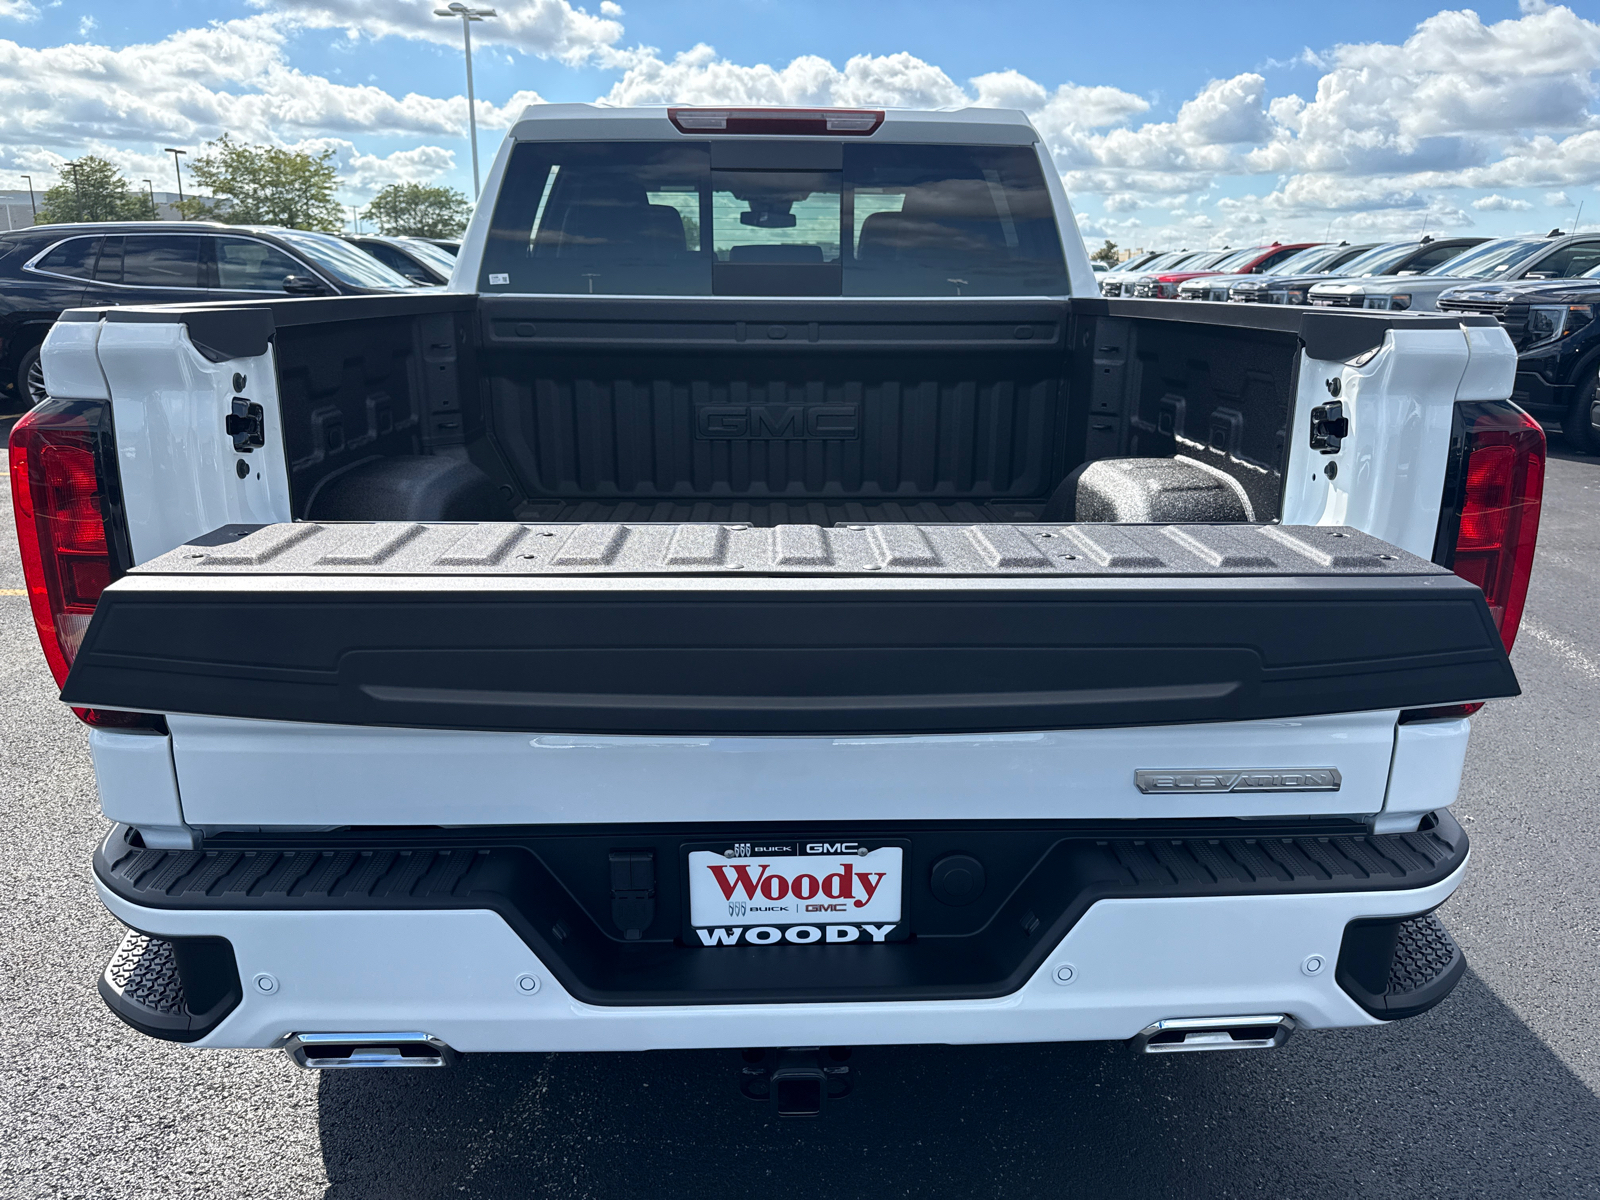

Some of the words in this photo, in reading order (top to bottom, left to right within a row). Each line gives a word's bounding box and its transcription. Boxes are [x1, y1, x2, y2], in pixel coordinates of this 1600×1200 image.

[698, 406, 856, 437] GMC
[1152, 773, 1327, 788] ELEVATION
[806, 843, 859, 853] GMC
[706, 863, 887, 908] Woody
[805, 903, 847, 912] GMC
[696, 924, 897, 946] WOODY
